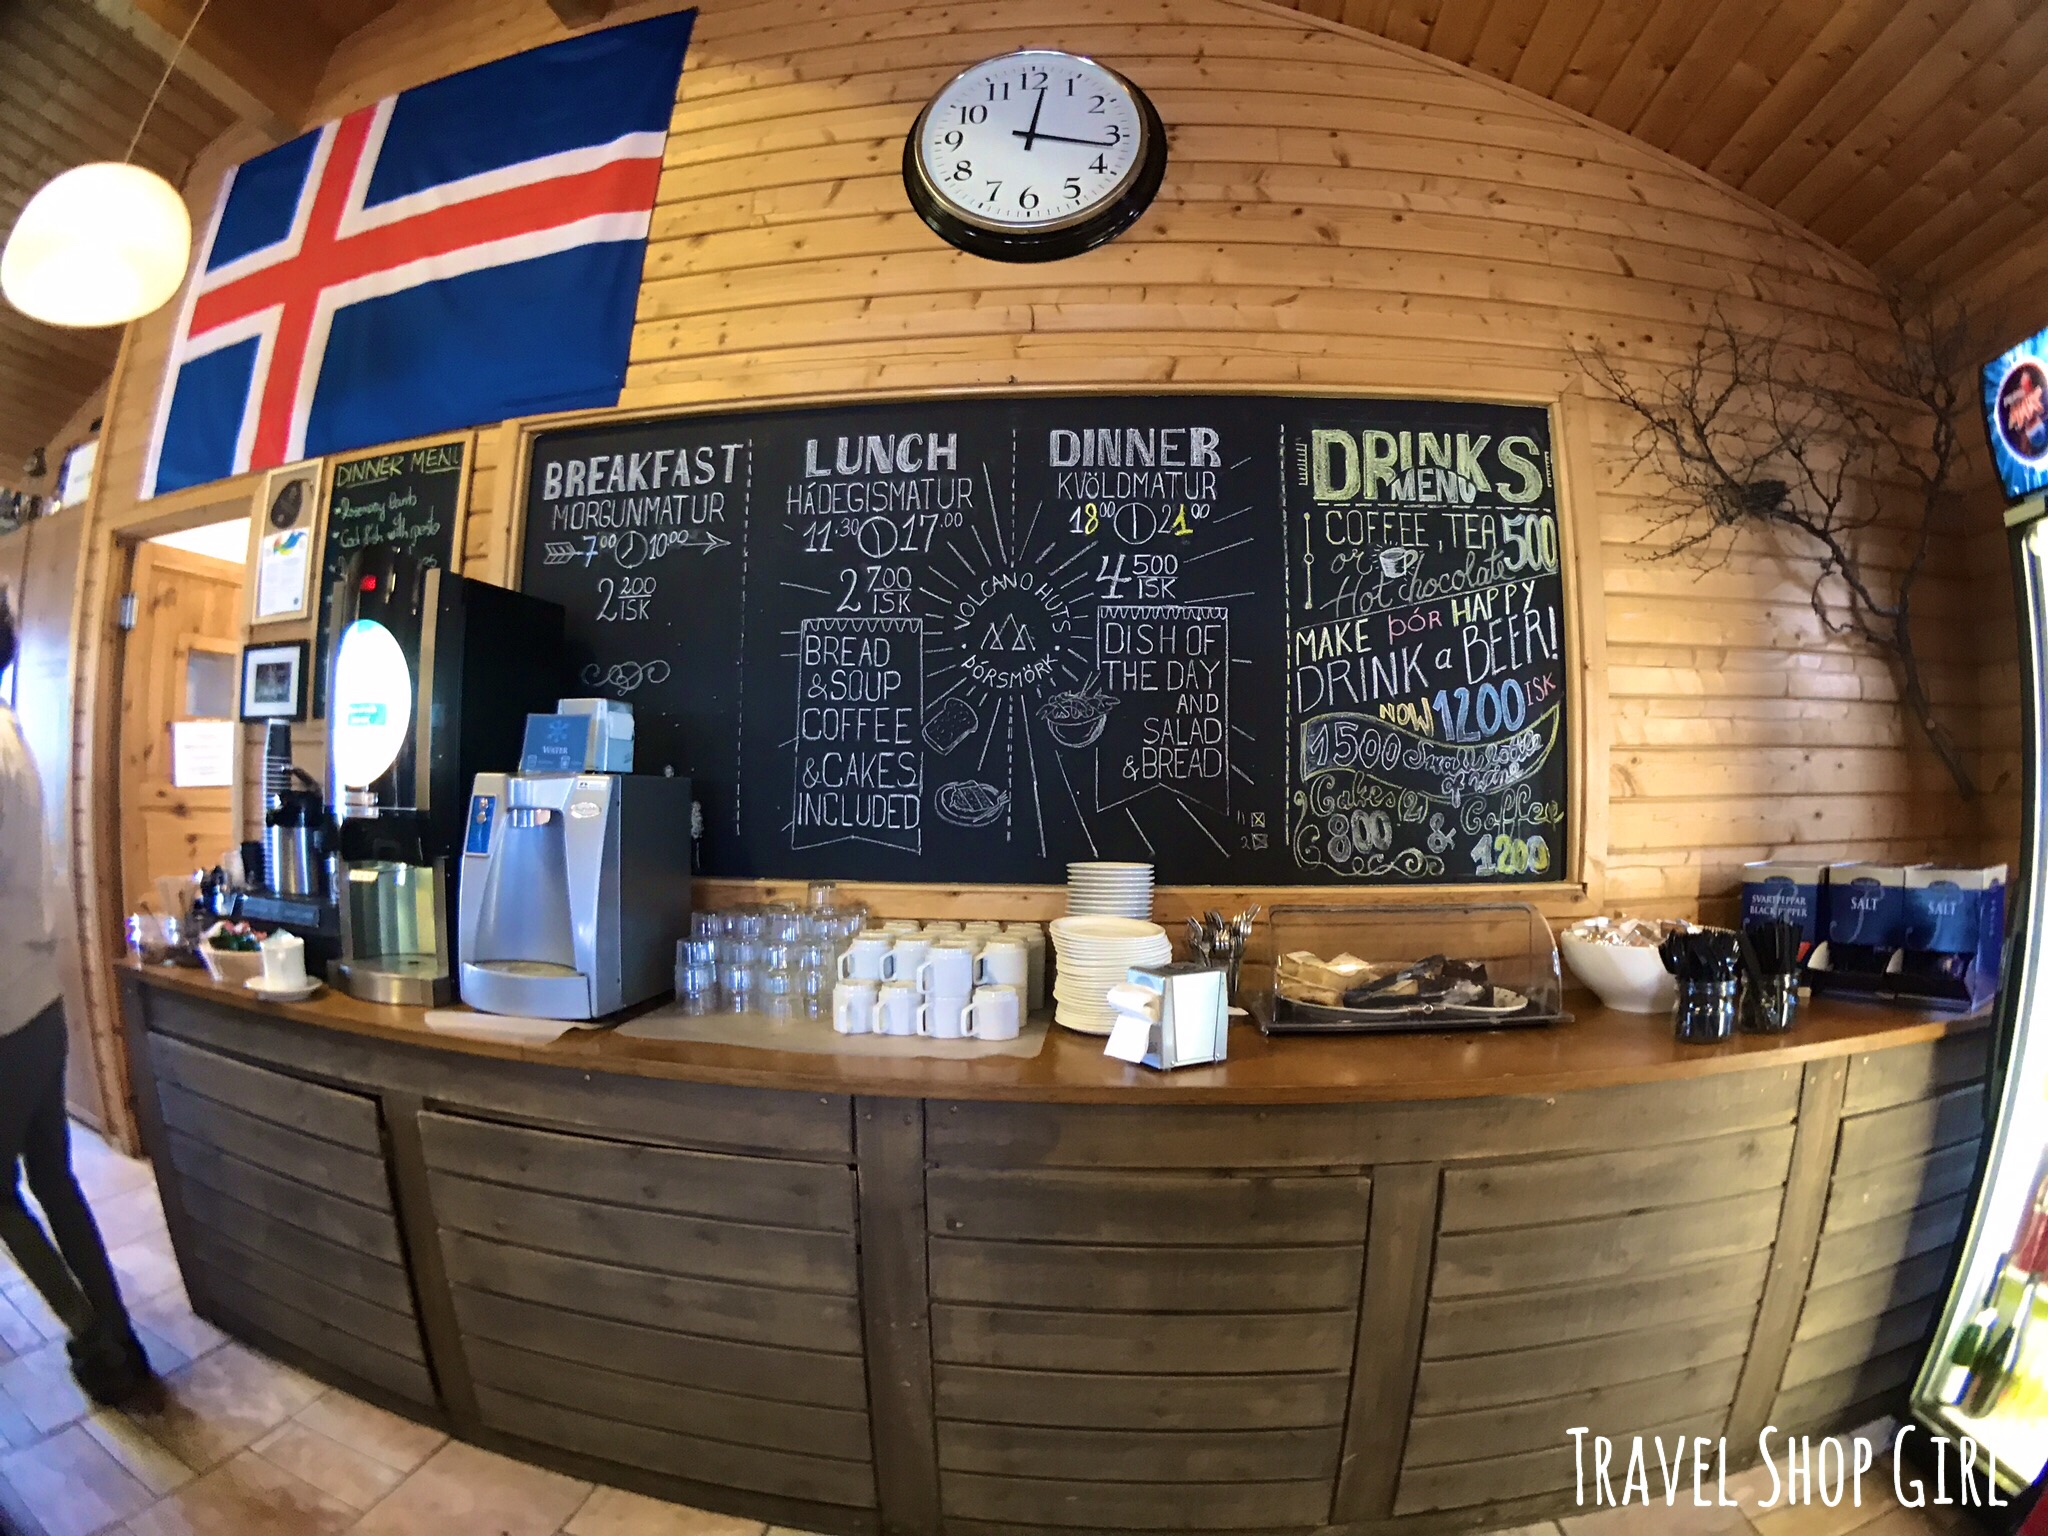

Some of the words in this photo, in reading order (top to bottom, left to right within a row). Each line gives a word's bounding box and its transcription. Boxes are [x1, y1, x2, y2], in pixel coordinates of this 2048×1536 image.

[987, 82, 1009, 101] 11
[1021, 71, 1049, 91] 12
[1066, 78, 1075, 96] 1
[960, 104, 988, 125] 10
[1088, 95, 1105, 114] 2
[944, 130, 964, 152] 9
[1105, 125, 1120, 145] 3
[953, 160, 973, 181] 8
[1088, 153, 1108, 174] 4
[986, 180, 1003, 202] 7
[1019, 186, 1039, 209] 6
[1063, 176, 1082, 199] 5
[805, 432, 957, 478] LUNCH
[1049, 427, 1222, 468] DINNER
[336, 456, 404, 487] DINNER
[543, 443, 744, 500] BREAKFAST
[1311, 428, 1543, 504] DRINKS
[786, 477, 974, 515] HÁDEGISMATUR
[1057, 471, 1217, 500] KVÖLDMATUR
[1391, 467, 1477, 504] MENU
[552, 492, 725, 531] MORGUNMATUR
[1441, 513, 1497, 550] TEA
[1501, 513, 1558, 573] 500
[873, 593, 911, 614] ISK
[953, 572, 1034, 631] VOLCANO
[1034, 582, 1072, 634] HUTS
[1138, 577, 1177, 600] ISK
[620, 599, 650, 621] ISK
[1296, 618, 1372, 666] MAKE
[1451, 580, 1536, 627] HAPPY
[805, 634, 890, 667] BREAD
[1105, 622, 1176, 655] DISH
[1186, 624, 1222, 656] OF
[1102, 660, 1158, 691] THE
[1167, 658, 1220, 691] DAY
[1297, 643, 1430, 713] DRINK
[1435, 648, 1453, 669] a
[1462, 606, 1559, 685] BEER!
[1176, 693, 1219, 714] AND
[1379, 697, 1435, 738] NOW
[1432, 678, 1527, 743] 1200
[1524, 672, 1557, 706] ISK
[802, 707, 913, 744] COFFEE
[1143, 717, 1223, 746] SALAD
[1310, 721, 1402, 771] 1500
[798, 791, 921, 829] INCLUDED
[1327, 808, 1393, 863] 800
[1427, 812, 1456, 854] &
[1470, 834, 1551, 877] 1200
[1850, 897, 1877, 911] SALT
[1928, 901, 1956, 916] SALT
